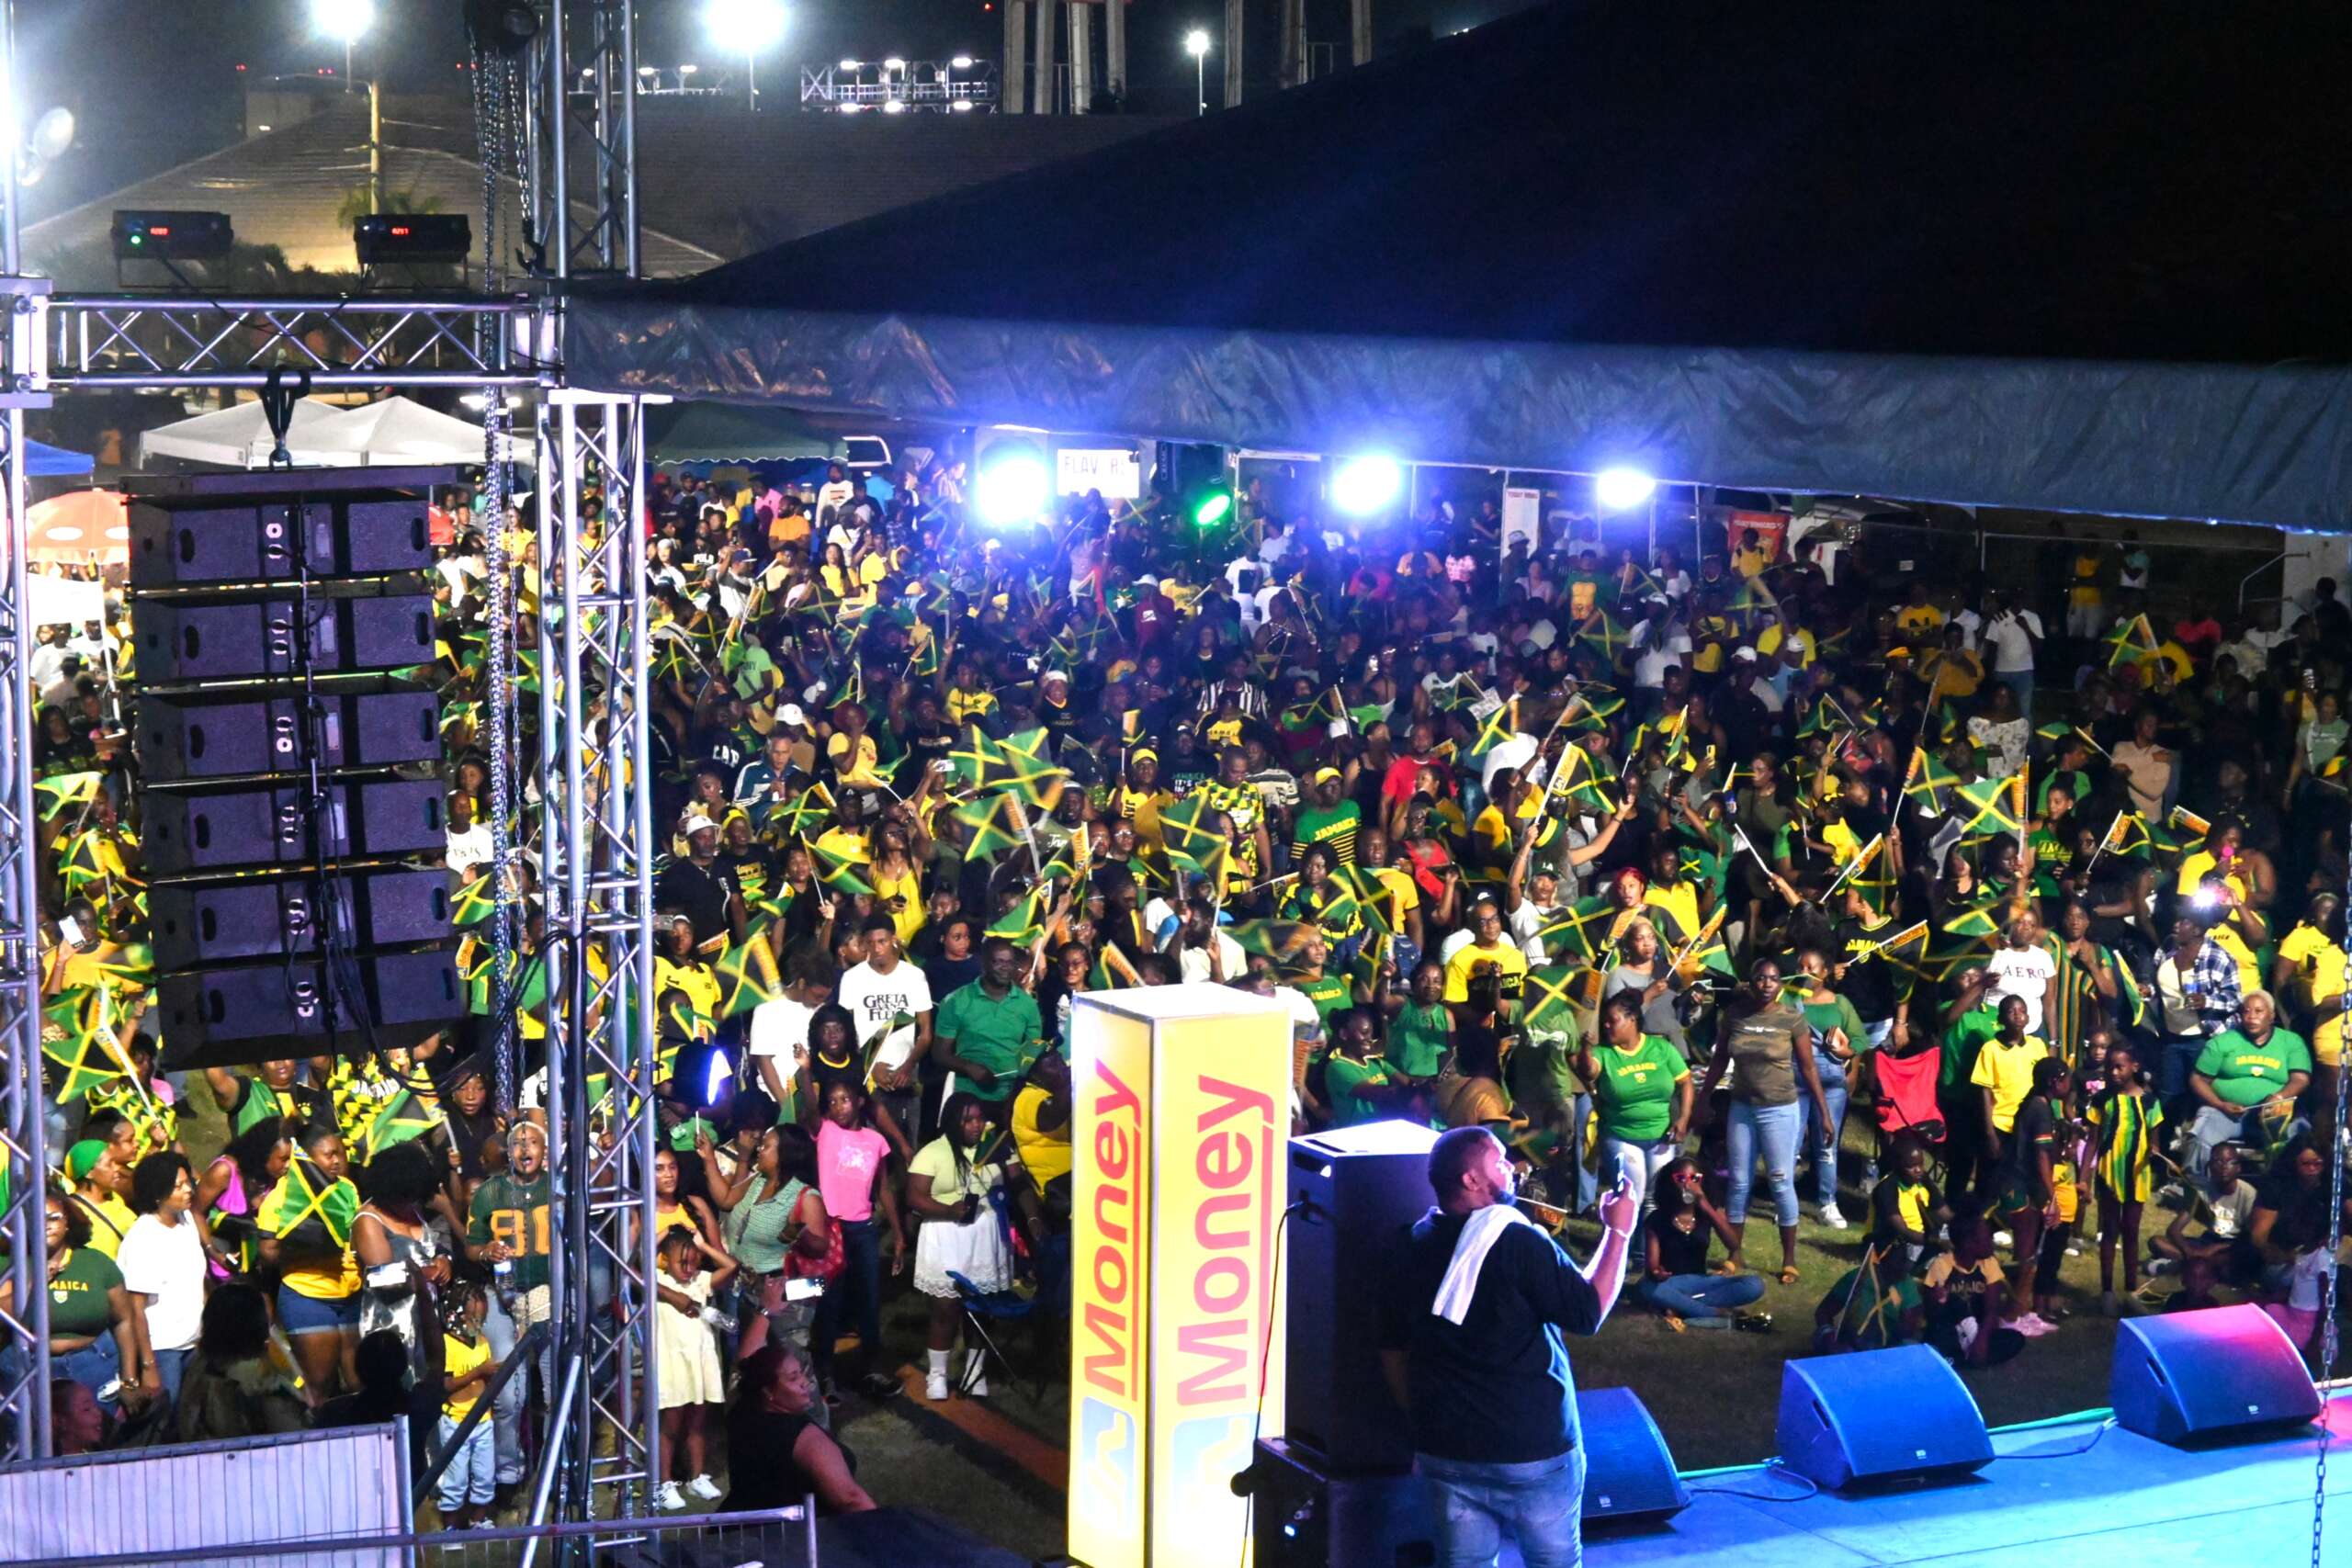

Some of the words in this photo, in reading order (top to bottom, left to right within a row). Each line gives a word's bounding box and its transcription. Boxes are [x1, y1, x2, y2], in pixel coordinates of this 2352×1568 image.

[863, 994, 909, 1009] GRETA
[48, 1280, 89, 1292] MAICA
[1083, 1057, 1142, 1396] Money
[1177, 1074, 1274, 1406] Money
